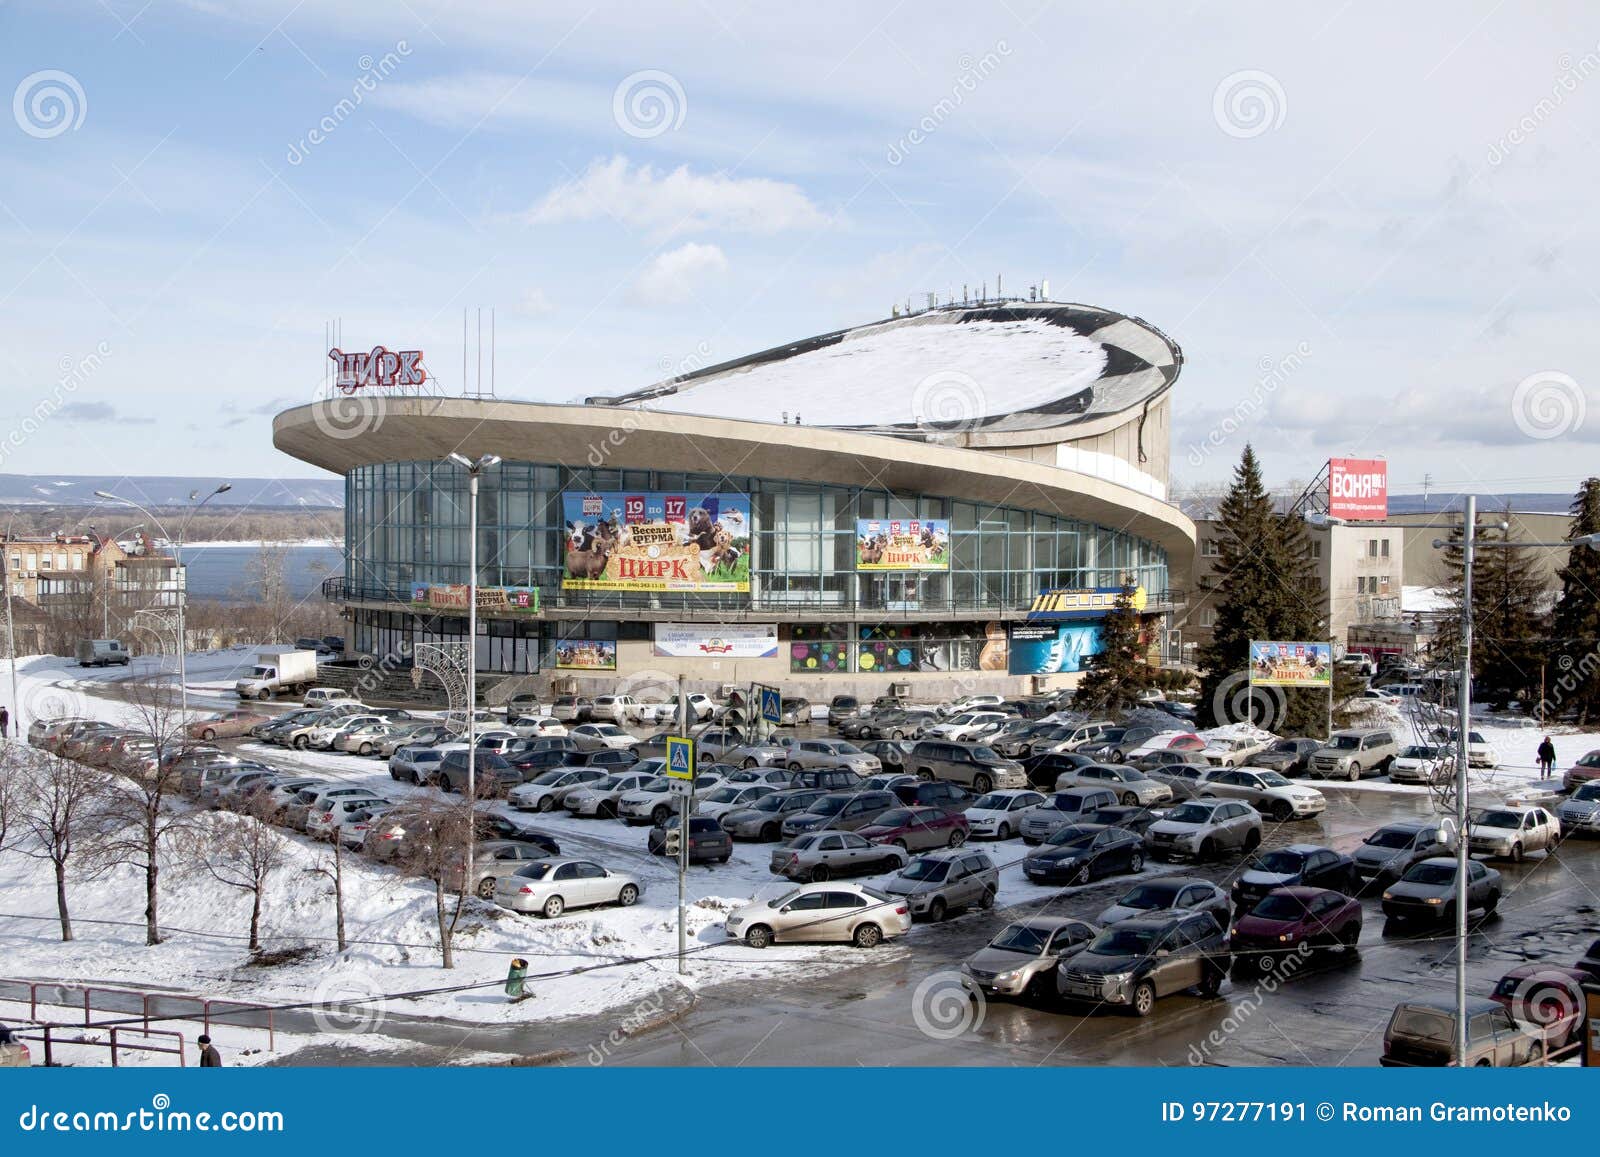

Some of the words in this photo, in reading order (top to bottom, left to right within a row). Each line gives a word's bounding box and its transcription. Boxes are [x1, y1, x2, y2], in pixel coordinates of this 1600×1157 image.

[328, 346, 426, 395] ЦИРК
[626, 501, 644, 514] 19
[648, 506, 662, 514] по
[666, 501, 684, 514] 17
[632, 533, 674, 545] ФЕРМА
[618, 557, 689, 579] ЦИРК
